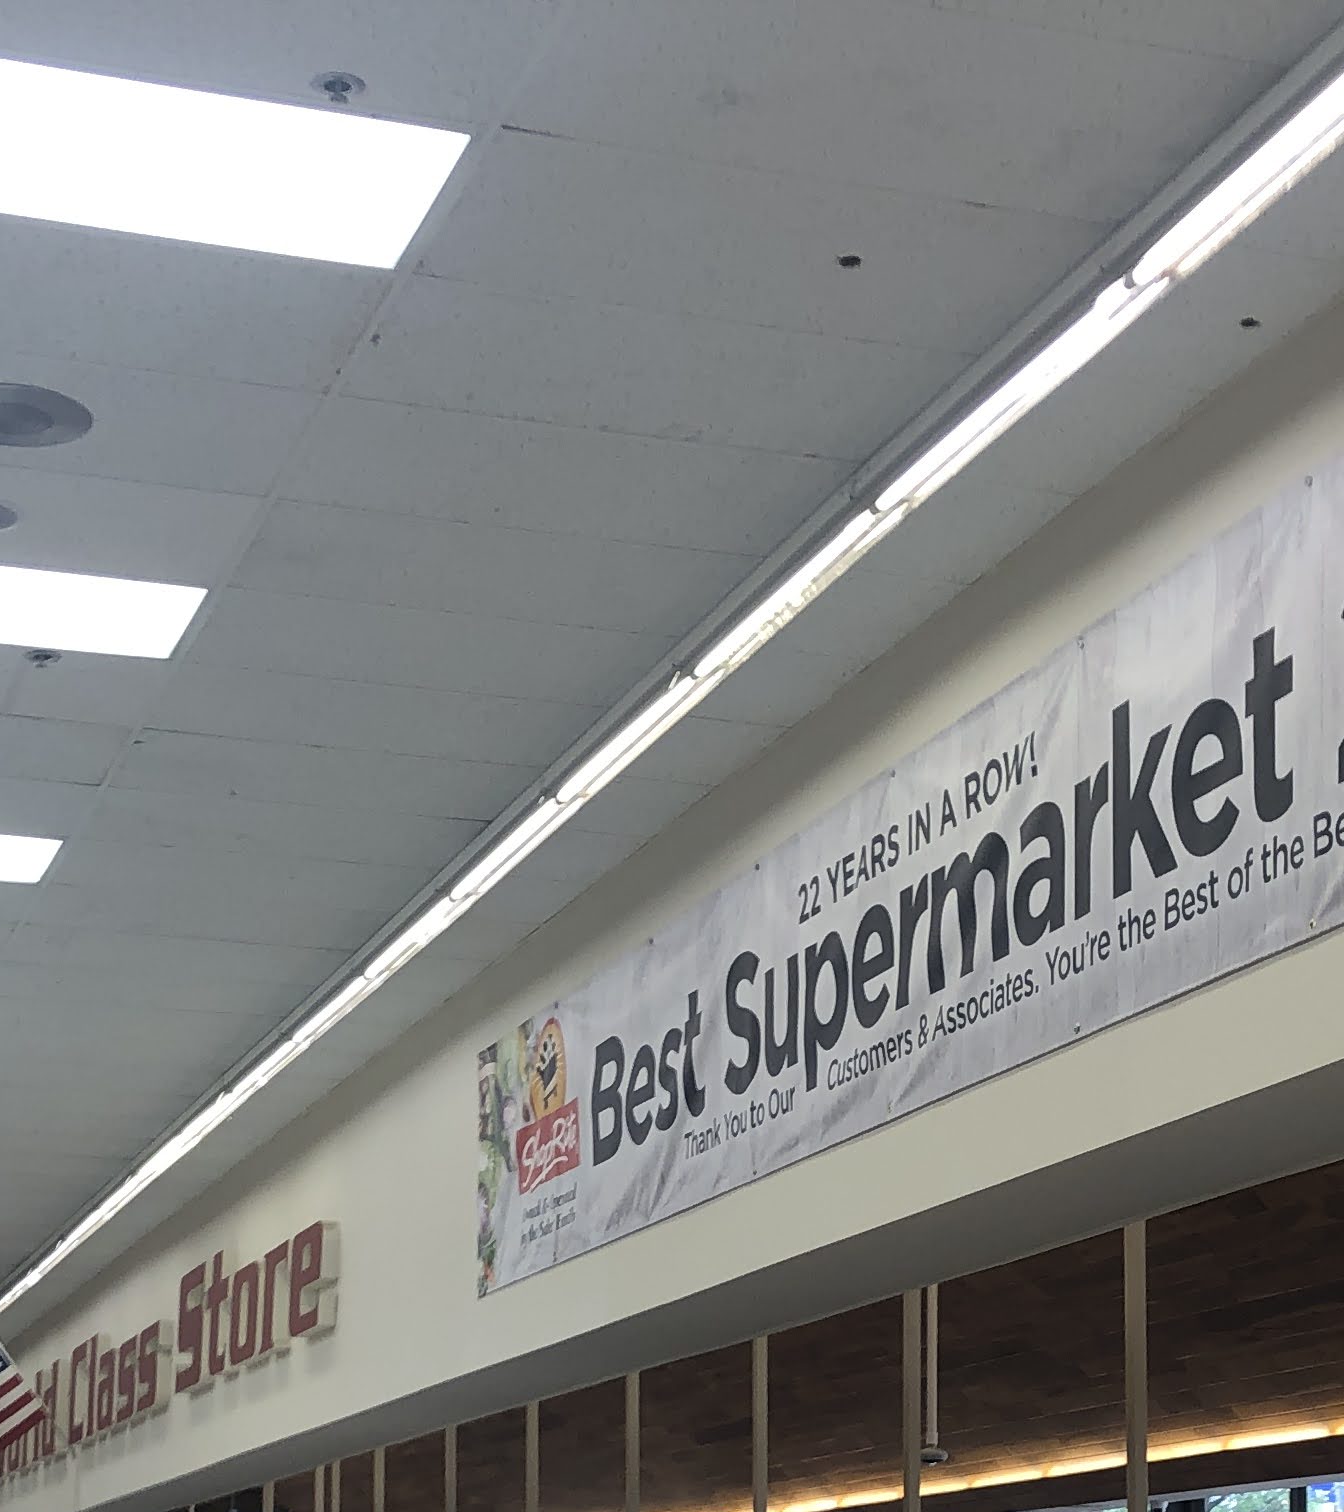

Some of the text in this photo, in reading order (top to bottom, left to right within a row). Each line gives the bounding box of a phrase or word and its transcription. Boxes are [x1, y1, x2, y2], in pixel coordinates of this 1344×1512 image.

[591, 989, 707, 1167] Best
[723, 626, 1294, 1093] Supermarket
[797, 730, 1040, 925] 22 YEARS IN A ROW!
[683, 1113, 722, 1160] Thank
[723, 1105, 748, 1143] You
[749, 1100, 765, 1130] to
[767, 1085, 796, 1121] Our
[826, 1024, 914, 1092] Customers
[917, 1015, 929, 1047] &
[930, 966, 1041, 1042] Associates.
[1044, 931, 1112, 987] You're
[1117, 903, 1157, 953] the
[1163, 868, 1221, 932] Best
[1226, 847, 1254, 900] of
[1260, 834, 1306, 885] the
[67, 1220, 328, 1445] Class Store
